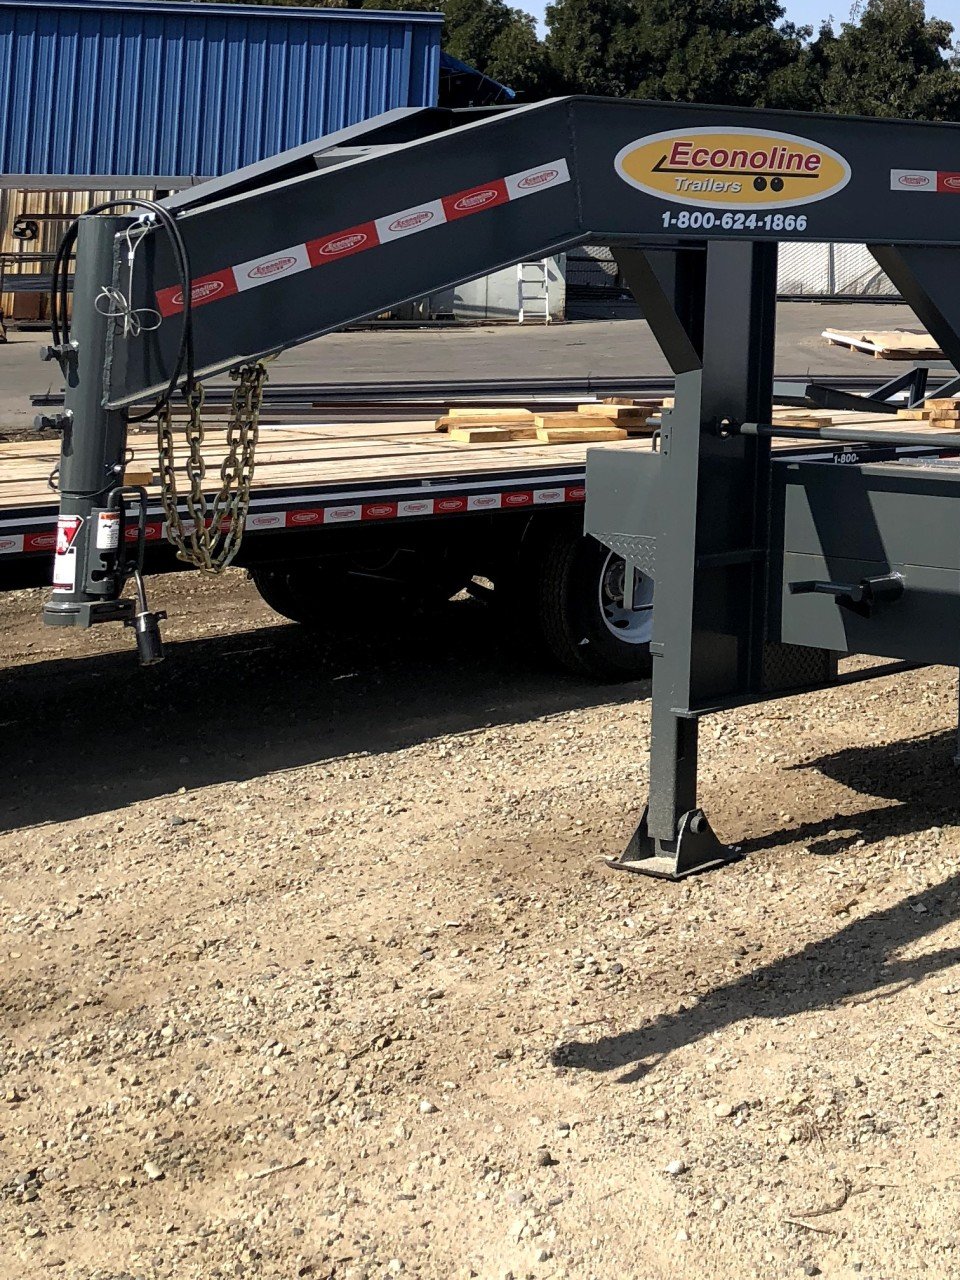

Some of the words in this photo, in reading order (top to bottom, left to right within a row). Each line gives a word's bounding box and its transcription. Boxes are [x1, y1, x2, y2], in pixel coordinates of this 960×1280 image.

[669, 141, 822, 171] Econoline
[674, 176, 742, 193] Trailers
[661, 210, 808, 231] 1-800-624-1866
